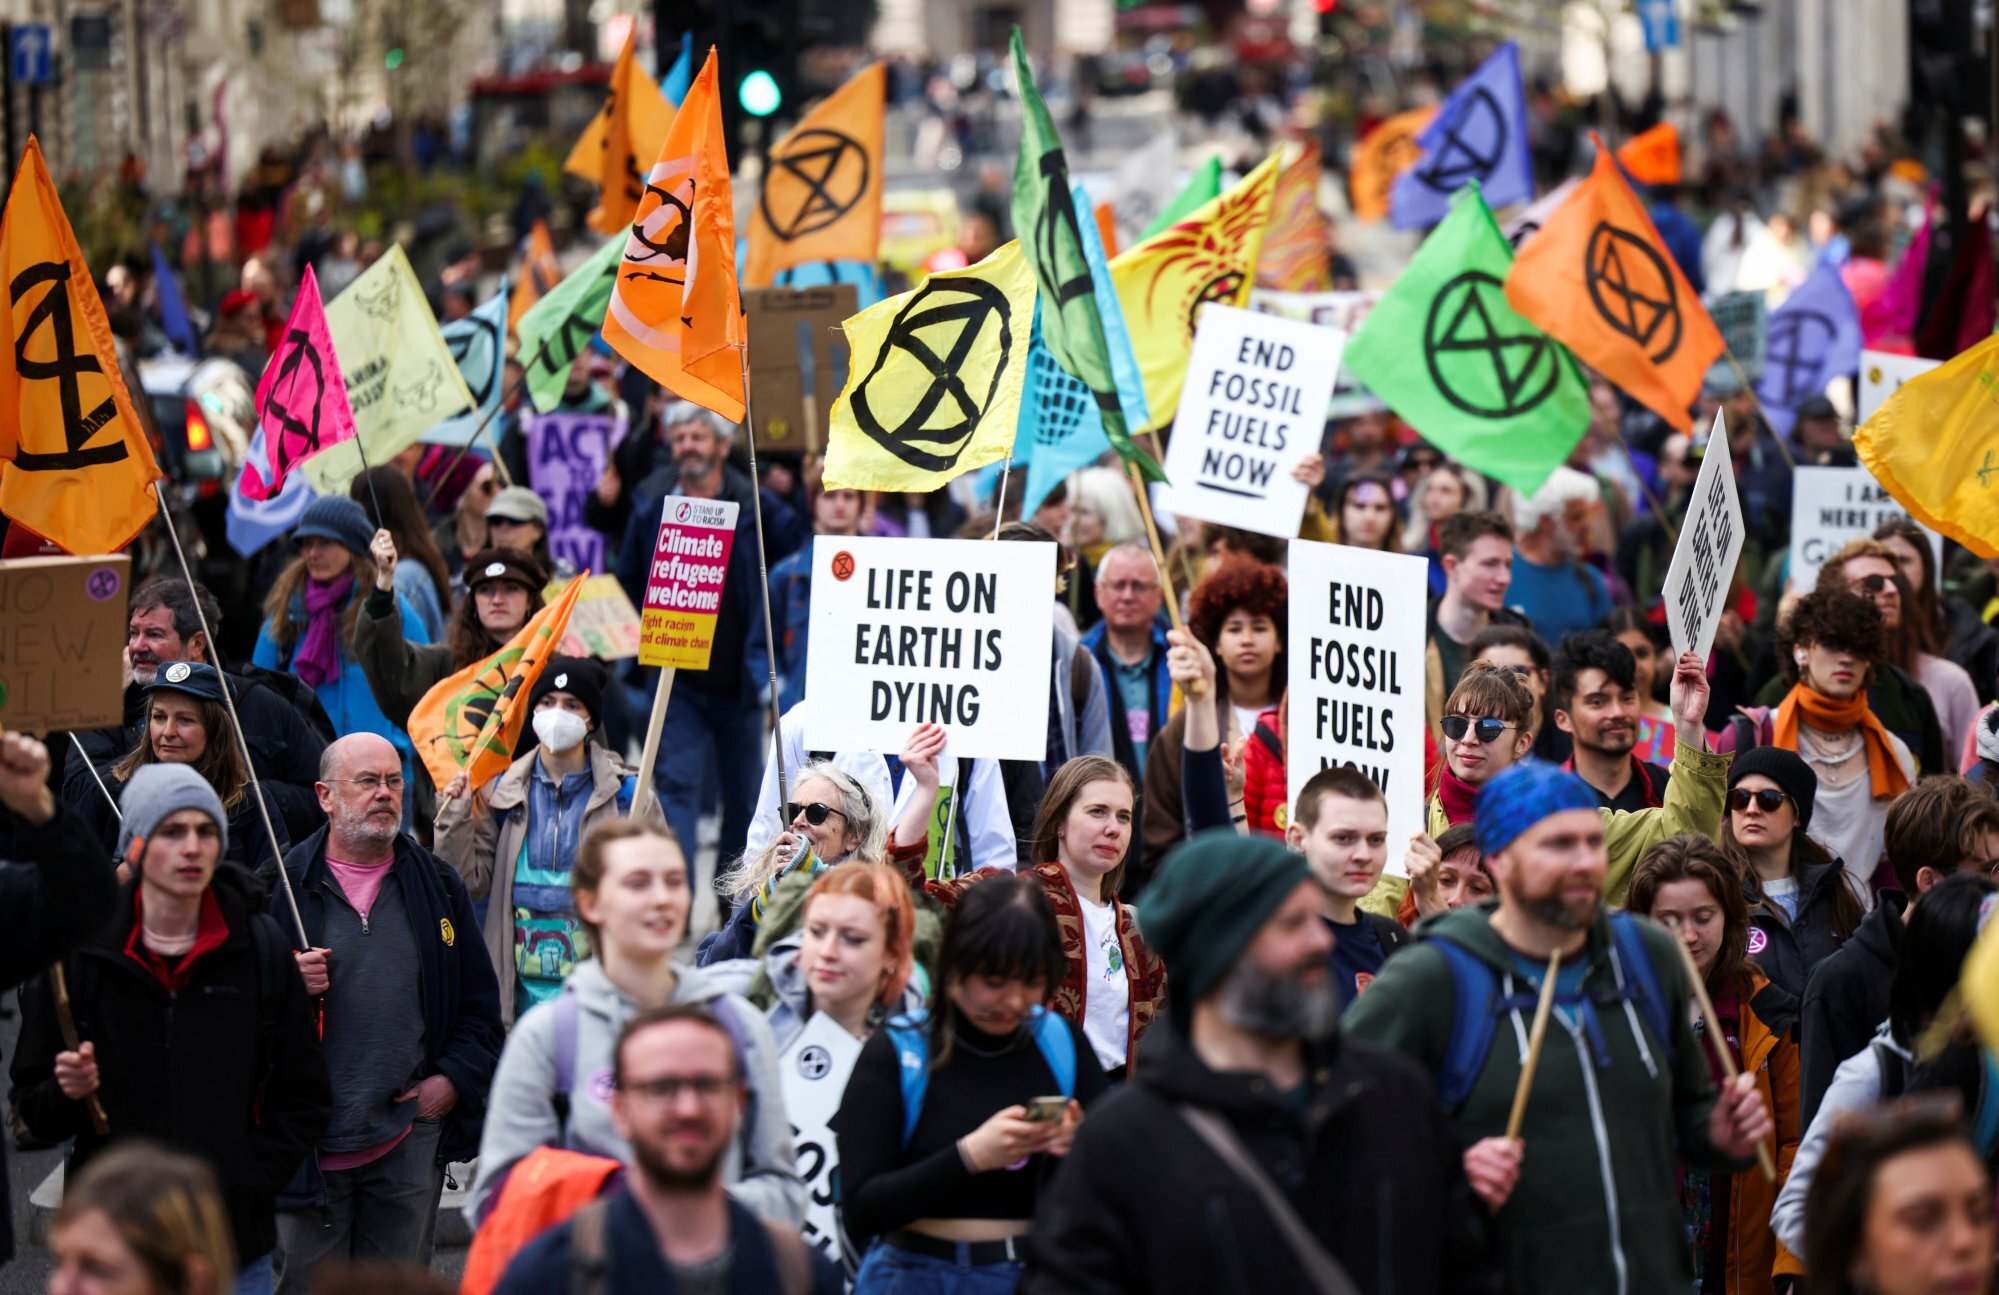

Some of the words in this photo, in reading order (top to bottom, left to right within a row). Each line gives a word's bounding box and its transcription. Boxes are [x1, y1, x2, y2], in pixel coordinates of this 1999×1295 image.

[1237, 336, 1295, 372] END
[1209, 369, 1302, 415] FOSSIL
[1206, 409, 1289, 451] FUELS
[1201, 448, 1277, 488] NOW
[693, 504, 714, 515] STAND
[714, 507, 724, 516] UP
[1708, 463, 1726, 533] LIFE
[1820, 508, 1867, 528] HERE
[1876, 511, 1913, 528] FO
[658, 527, 723, 558] Climate
[692, 515, 702, 524] TO
[702, 516, 725, 527] RACISM
[1716, 510, 1732, 567] ON
[652, 555, 725, 588] refugees
[1692, 507, 1714, 598] EARTH
[1704, 572, 1719, 619] IS
[648, 582, 719, 610] welcome
[867, 568, 933, 611] LIFE
[946, 571, 997, 614] ON
[1329, 581, 1384, 631] END
[1679, 565, 1702, 652] DYING
[655, 633, 688, 648] climate
[665, 619, 695, 632] racism
[855, 623, 962, 669] EARTH
[973, 629, 1002, 671] IS
[1310, 637, 1402, 695] FOSSIL
[871, 680, 980, 726] DYING
[1316, 697, 1394, 753] FUELS
